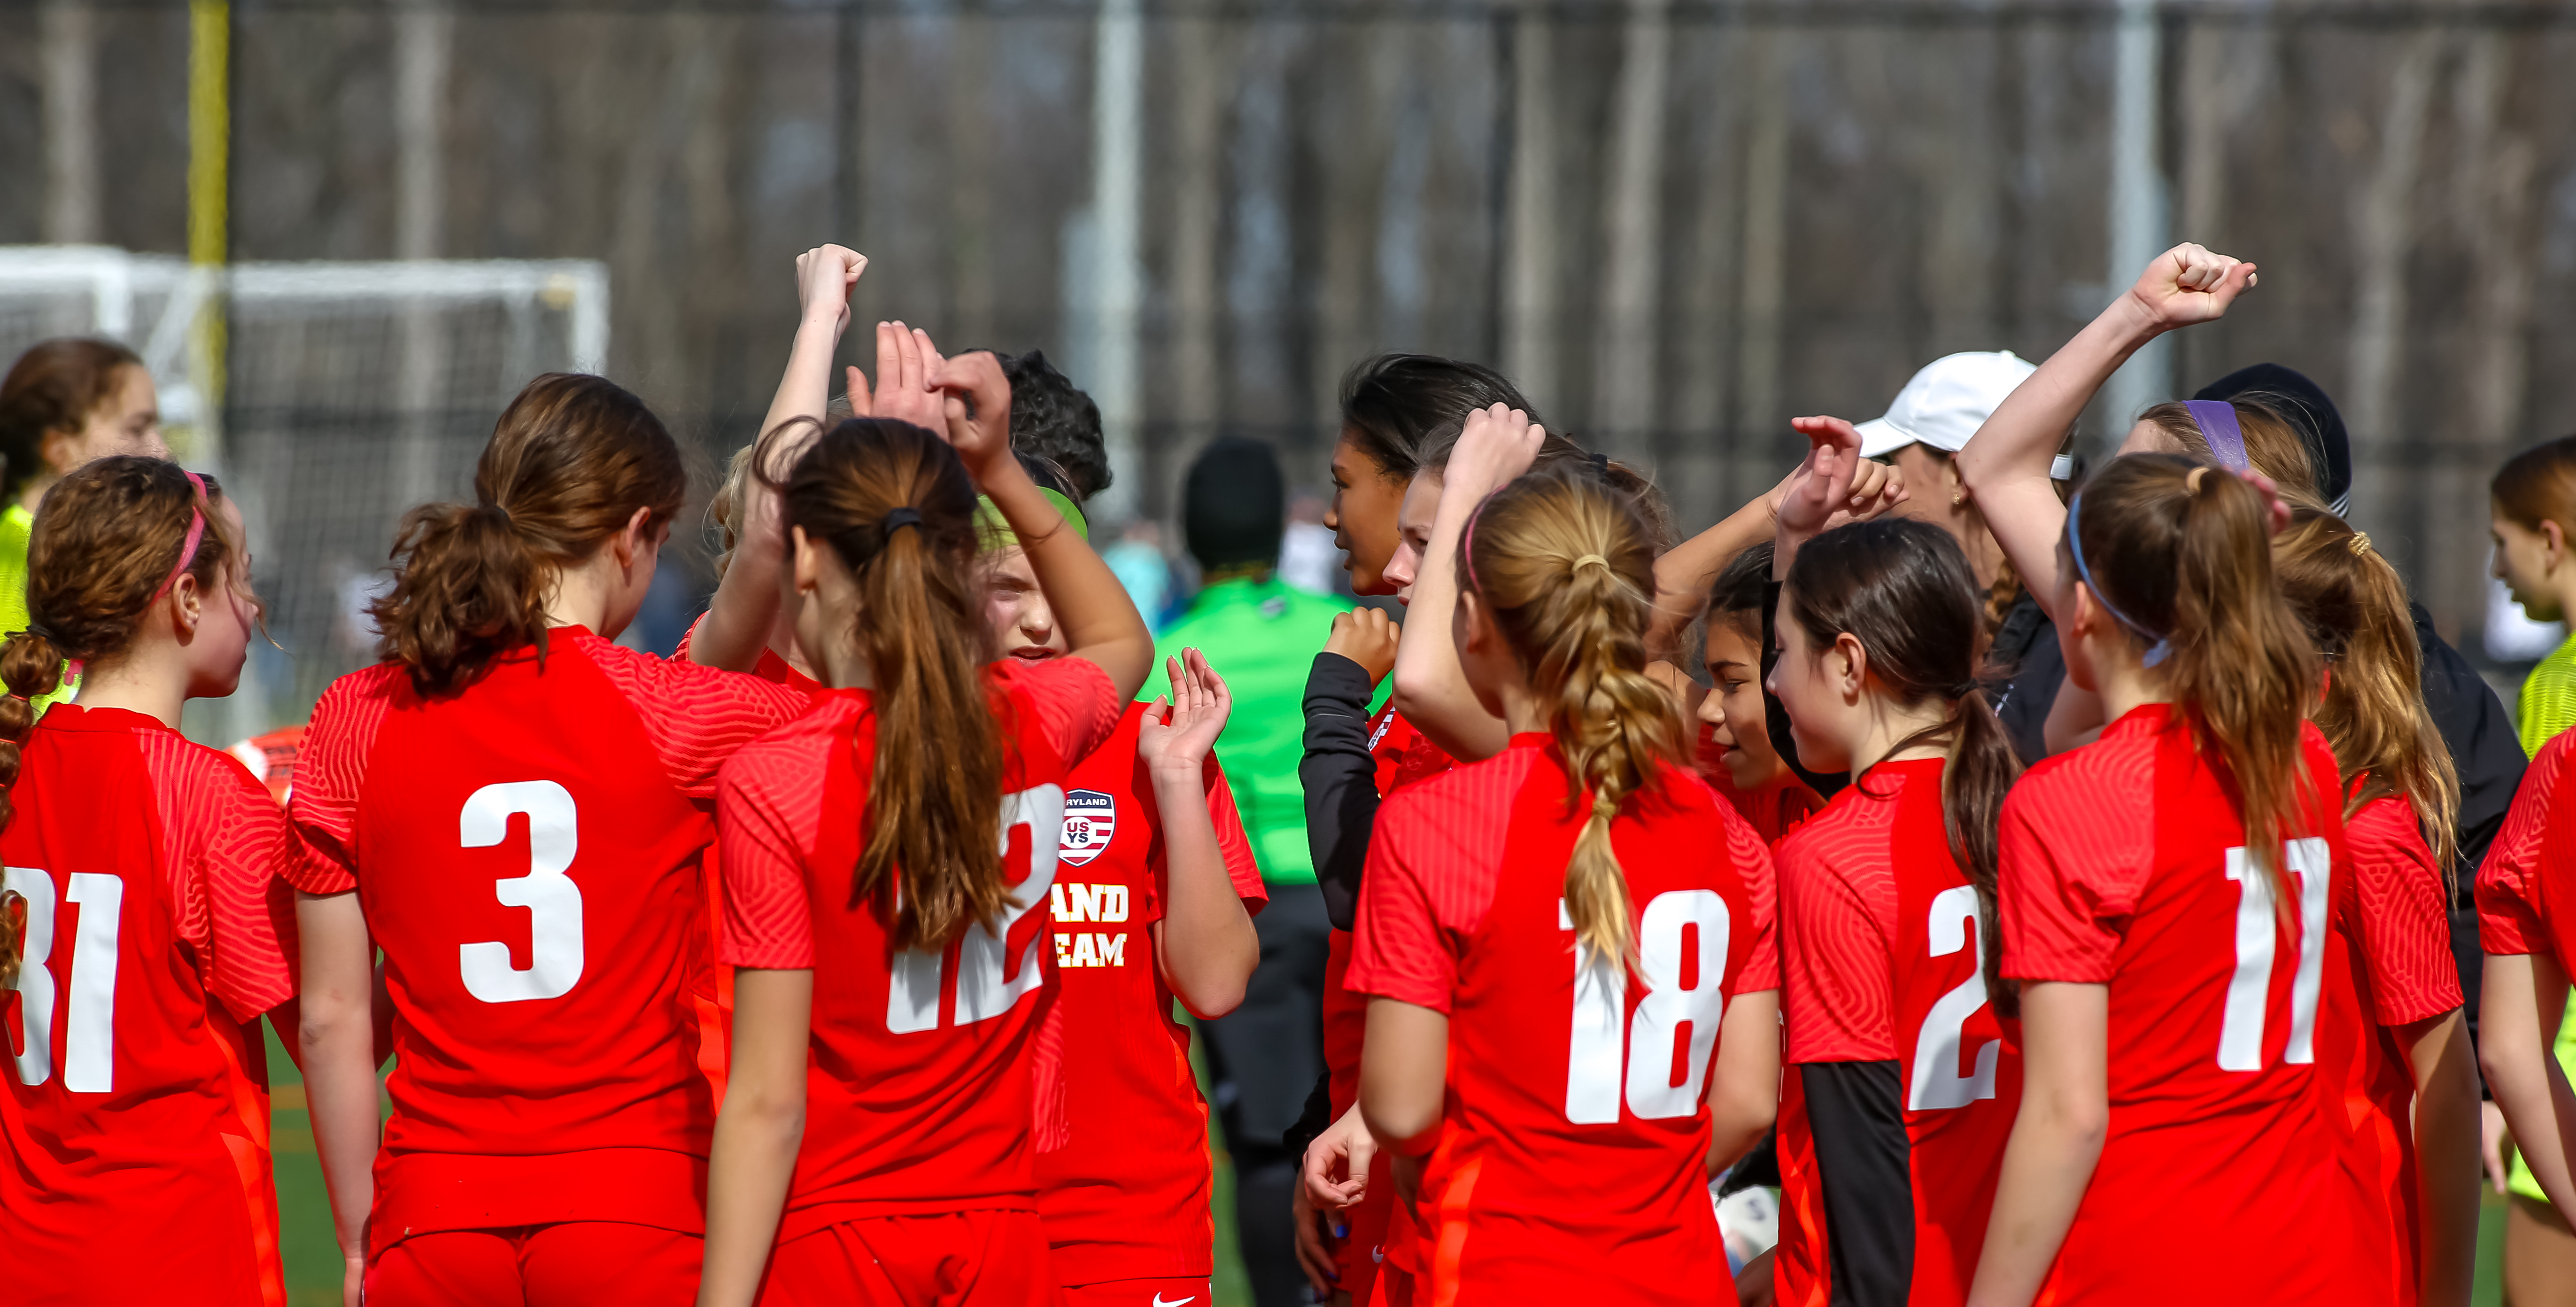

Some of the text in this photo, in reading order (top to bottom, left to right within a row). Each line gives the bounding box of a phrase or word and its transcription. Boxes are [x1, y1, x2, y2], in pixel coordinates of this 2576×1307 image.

[459, 779, 585, 1004] 3
[1067, 822, 1089, 832] US
[1067, 832, 1089, 843] YS
[1053, 933, 1128, 968] EAM
[1558, 889, 1731, 1125] 18
[1908, 883, 2002, 1111] 2
[2217, 836, 2331, 1072] 11
